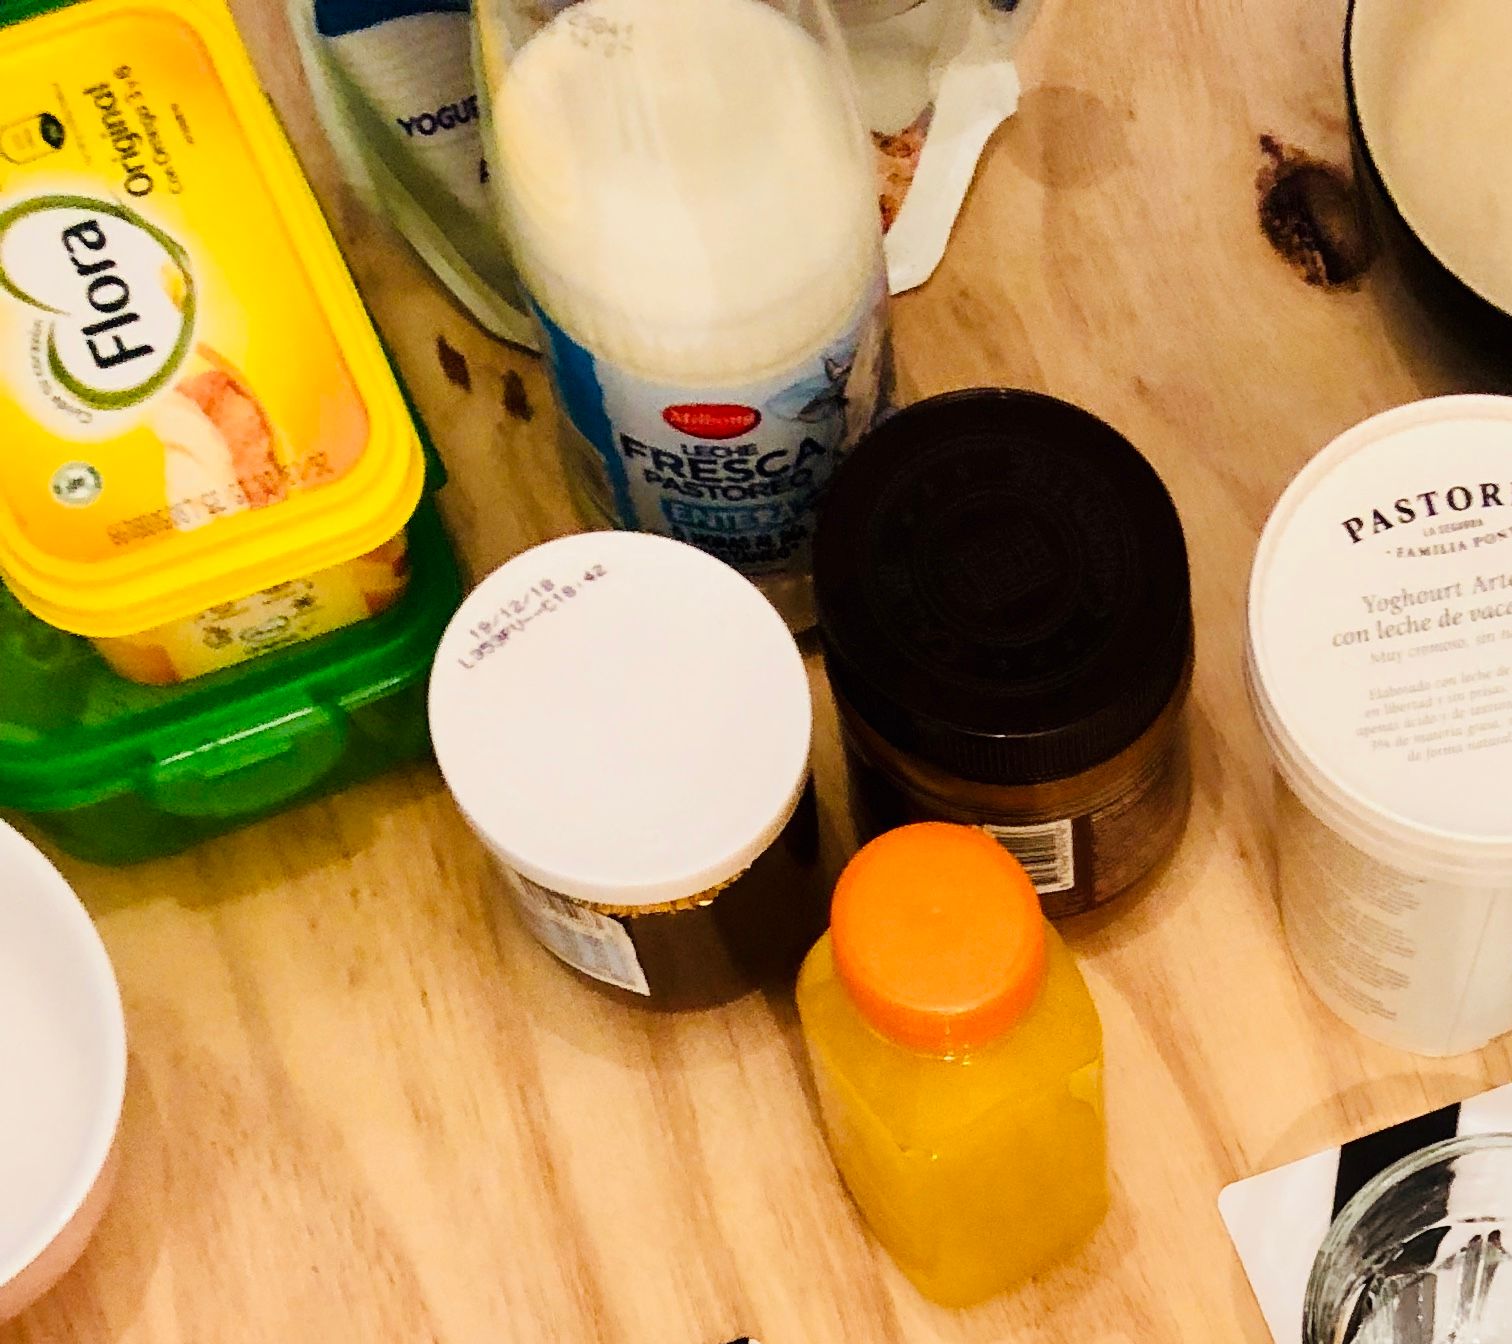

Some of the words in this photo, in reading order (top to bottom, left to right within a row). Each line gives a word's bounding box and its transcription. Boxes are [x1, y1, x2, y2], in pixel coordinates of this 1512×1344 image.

[83, 83, 154, 197] Original
[61, 219, 155, 369] Flora
[619, 432, 827, 484] FRESCA
[680, 443, 758, 459] LECHE
[1395, 540, 1468, 559] FAMILIA
[1361, 580, 1464, 616] Yoghourt
[1332, 626, 1371, 648] con
[1376, 615, 1432, 641] leche
[1437, 609, 1464, 630] de
